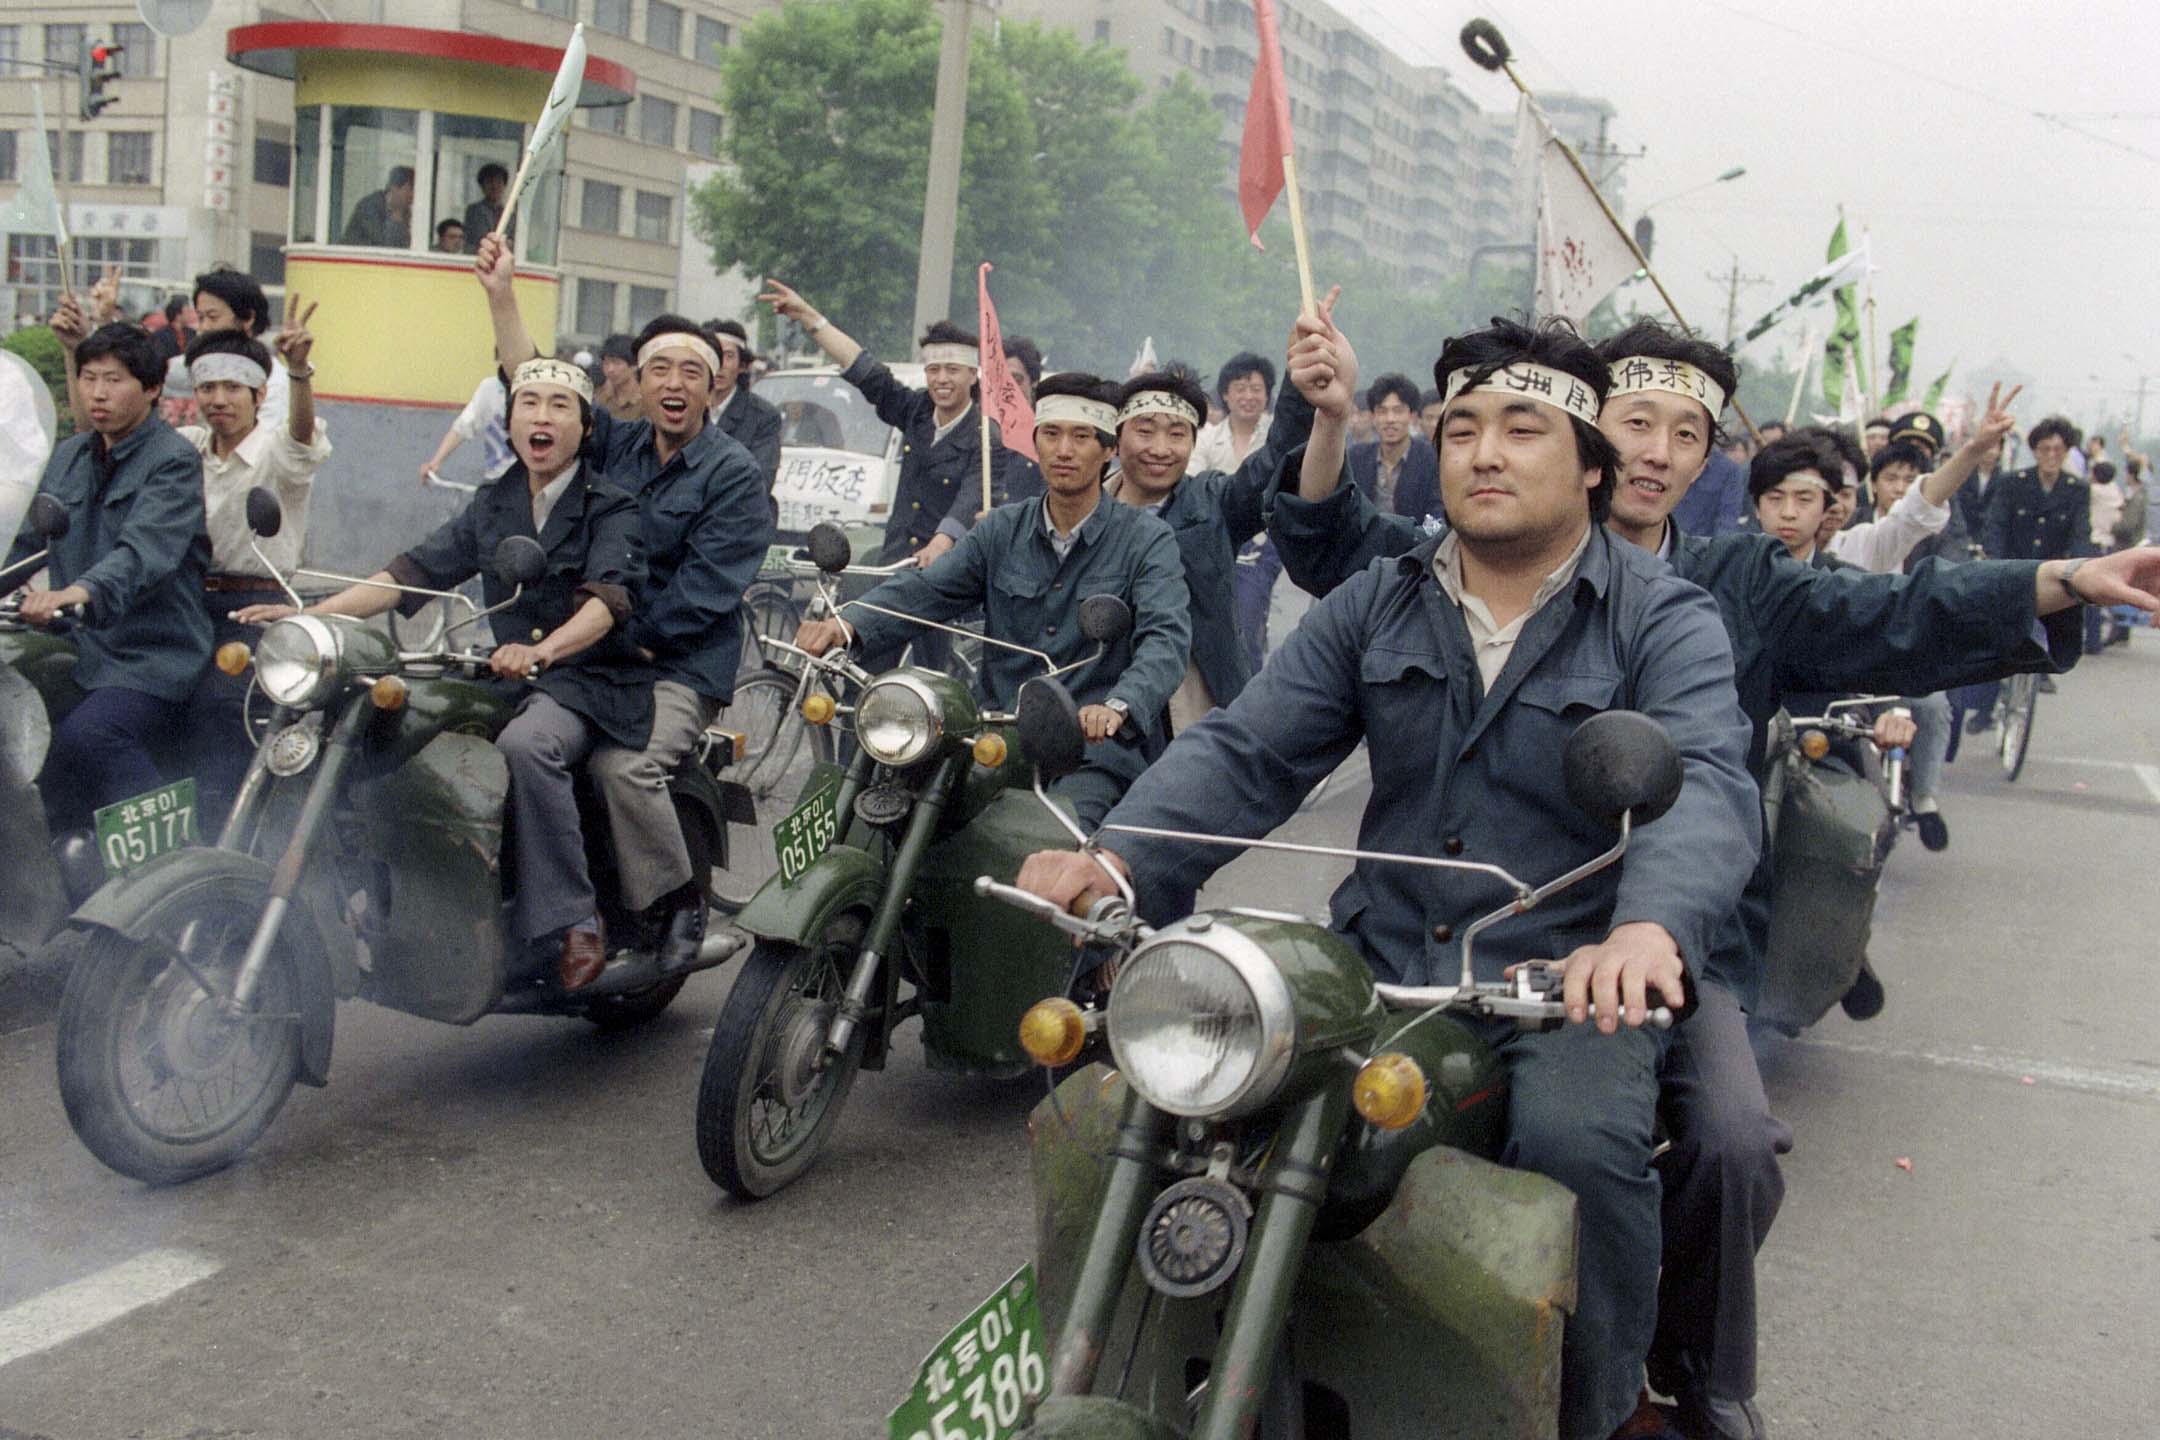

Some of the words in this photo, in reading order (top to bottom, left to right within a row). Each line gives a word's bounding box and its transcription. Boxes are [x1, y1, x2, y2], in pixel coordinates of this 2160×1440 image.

[106, 806, 192, 869] 05177
[782, 809, 836, 880] 05155
[907, 1328, 1045, 1440] 5386
[924, 1297, 1014, 1404] 北京01
